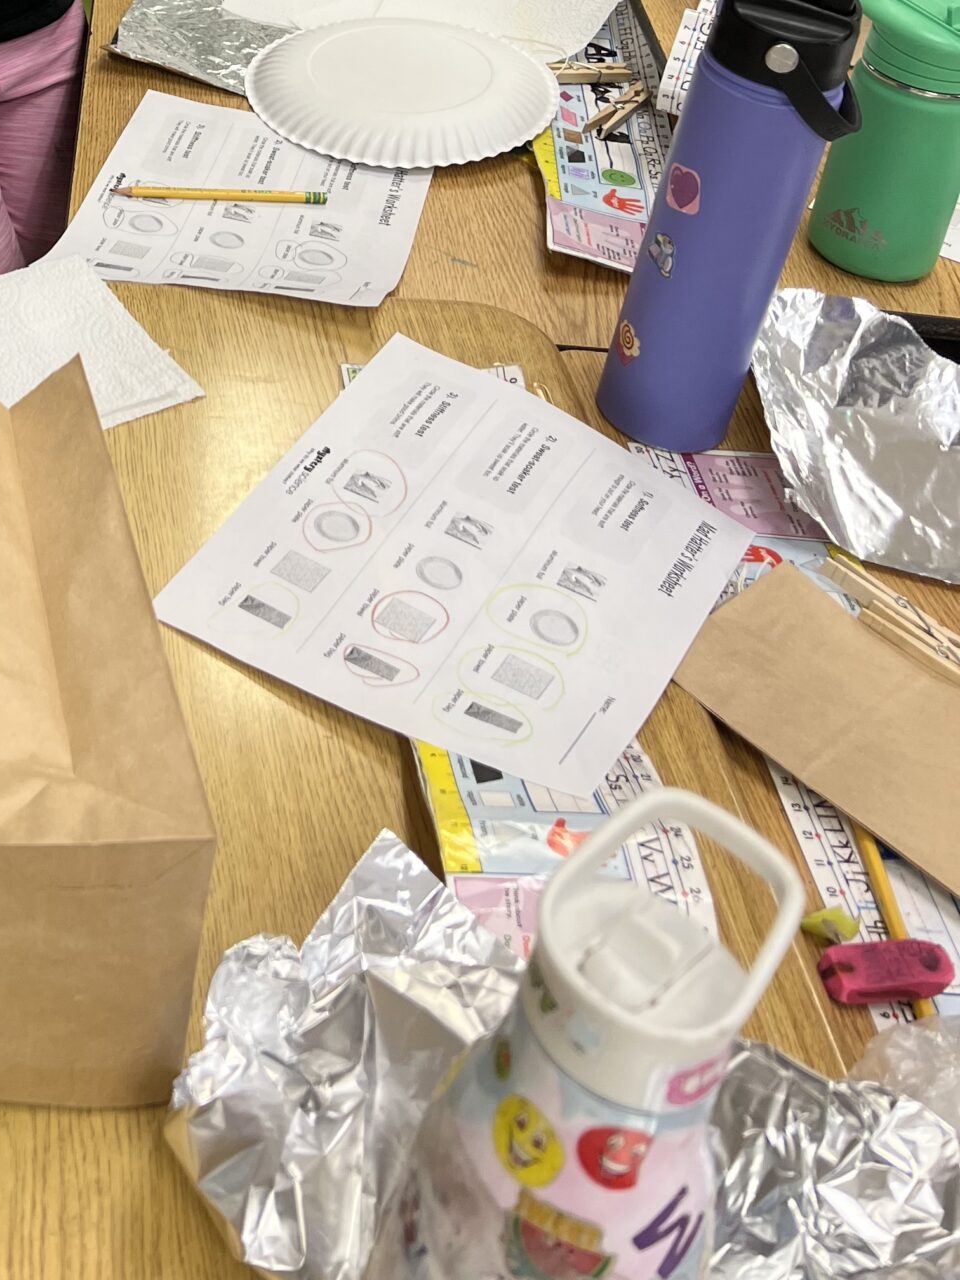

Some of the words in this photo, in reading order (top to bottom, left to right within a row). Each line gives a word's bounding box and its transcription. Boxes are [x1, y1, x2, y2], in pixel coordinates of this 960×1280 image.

[185, 131, 201, 150] Stiffness
[181, 149, 192, 159] test
[256, 175, 267, 184] test
[341, 180, 352, 190] test
[377, 193, 401, 226] Worksheet
[424, 399, 451, 426] Stiffness
[414, 423, 430, 437] test
[515, 443, 550, 482] Sweat-soaker
[663, 466, 687, 478] Yy
[685, 461, 703, 484] Word?
[283, 470, 310, 496] science
[506, 480, 521, 495] test
[626, 497, 649, 521] Softness
[619, 518, 634, 531] test
[695, 520, 718, 539] Mad
[679, 532, 710, 564] Hatter's
[539, 549, 560, 572] aluminum
[534, 569, 546, 579] foil
[656, 557, 694, 599] Worksheet
[512, 595, 529, 611] paper
[504, 609, 519, 623] plate
[479, 643, 496, 660] paper
[471, 658, 487, 673] towel
[448, 688, 465, 703] paper
[441, 701, 455, 713] bag
[605, 773, 629, 791] Ss
[638, 838, 663, 863] Vv
[791, 803, 802, 812] 13
[802, 830, 814, 840] 12
[826, 886, 838, 897] 10
[834, 839, 860, 866] Kk
[669, 826, 683, 838] 24
[679, 856, 695, 871] 25
[690, 887, 704, 903] 26
[845, 869, 872, 893] Jj
